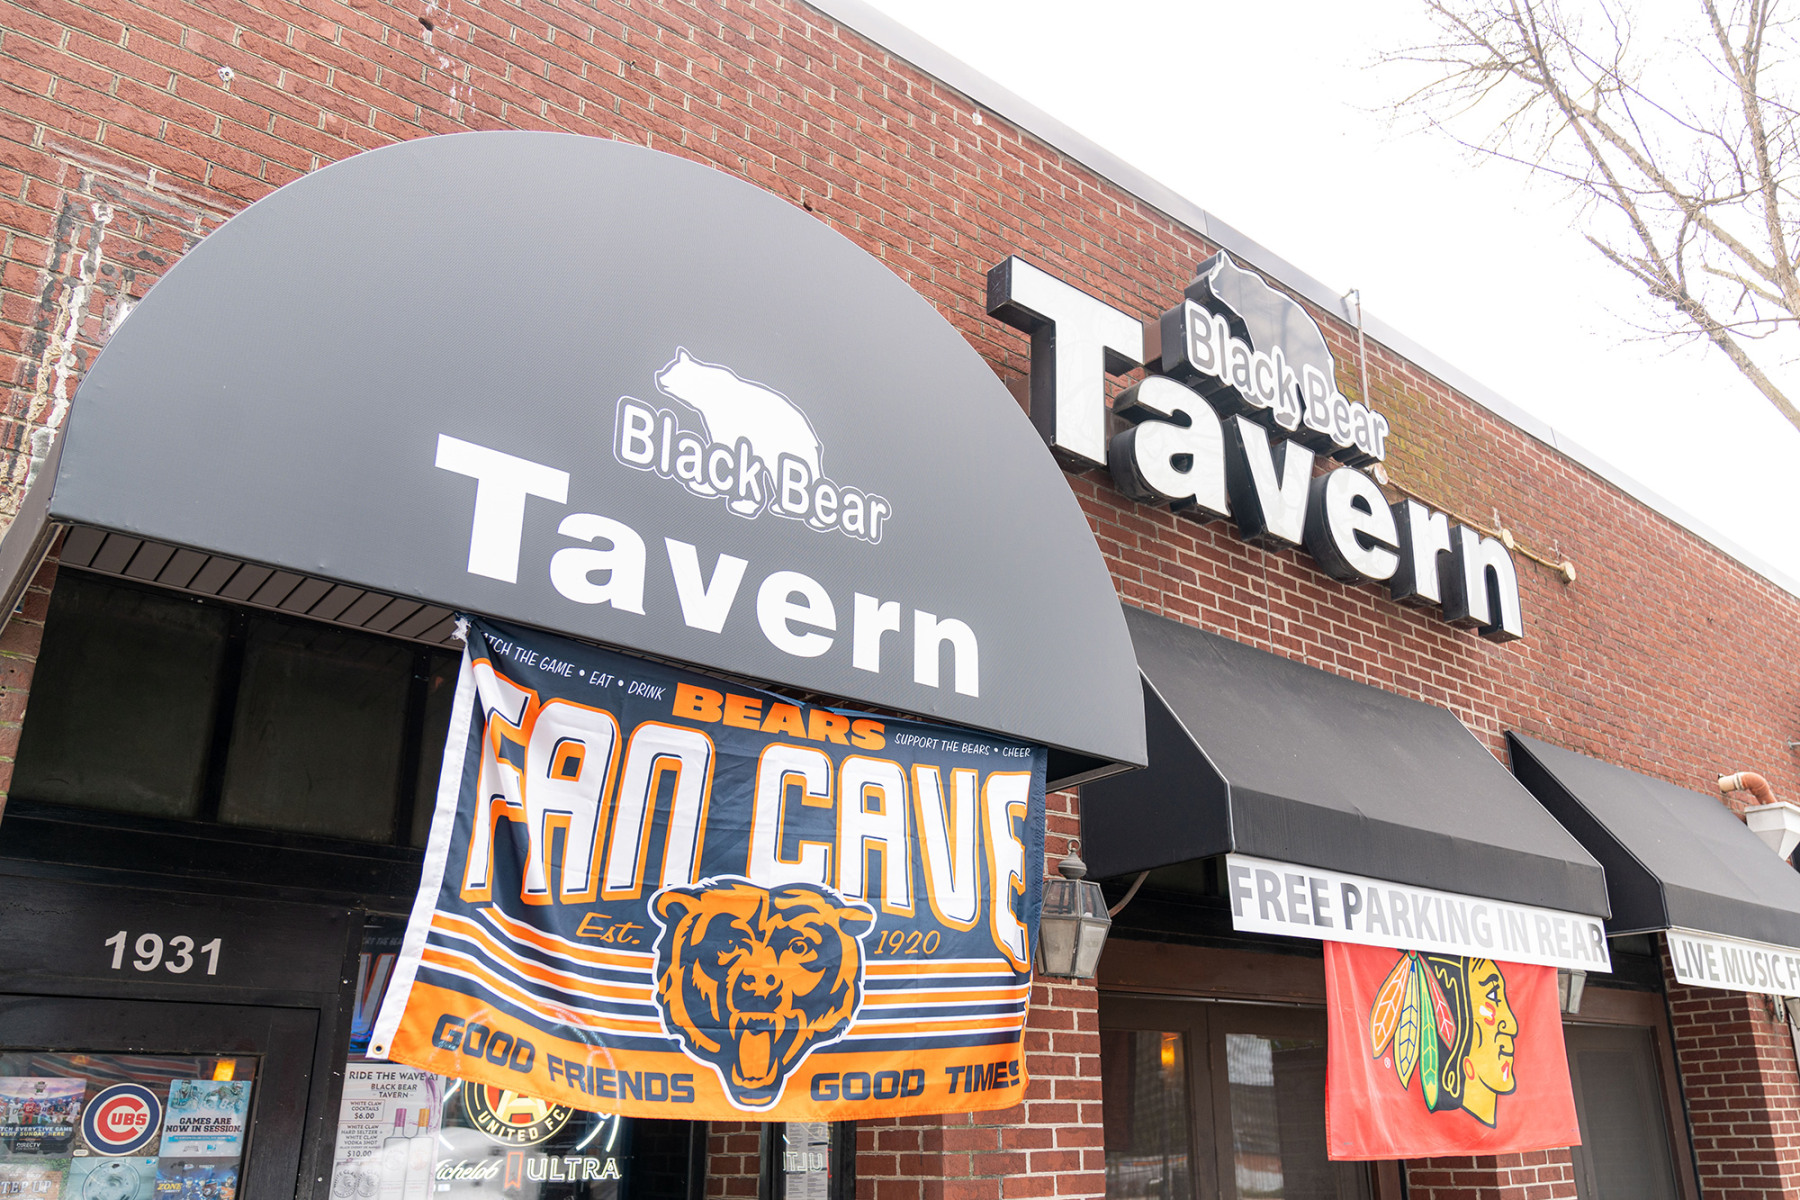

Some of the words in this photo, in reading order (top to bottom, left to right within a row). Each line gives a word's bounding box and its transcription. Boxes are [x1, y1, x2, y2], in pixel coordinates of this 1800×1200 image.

[1188, 302, 1299, 416] Black
[1304, 368, 1389, 459] Bear
[993, 254, 1523, 642] Tavern
[620, 402, 765, 503] Black
[779, 457, 889, 541] Bear
[435, 432, 980, 698] Tavern
[483, 632, 513, 656] TCH
[514, 646, 539, 666] THE
[539, 656, 575, 678] GAME
[589, 670, 615, 688] EAT
[627, 680, 667, 701] DRINK
[671, 681, 886, 751] BEARS
[894, 733, 939, 750] SUPPORT
[941, 740, 959, 752] THE
[961, 743, 991, 756] BEARS
[1002, 747, 1031, 758] CHEER
[461, 657, 715, 904] FAN
[744, 742, 1032, 974] CAVE
[574, 911, 641, 945] Est.
[874, 929, 941, 956] 1920
[1228, 864, 1334, 928] FREE
[1340, 882, 1494, 949] PARKING
[1497, 907, 1532, 956] IN
[1538, 913, 1609, 965] REAR
[105, 930, 222, 976] 1931
[1669, 937, 1721, 982] LIVE
[1720, 945, 1787, 990] MUSIC
[348, 1071, 373, 1080] RIDE
[375, 1071, 397, 1080] THE
[399, 1072, 425, 1081] WAVE
[426, 1072, 440, 1081] AT
[432, 1013, 536, 1075] GOOD
[547, 1052, 695, 1104] FRIENDS
[811, 1066, 924, 1102] GOOD
[944, 1058, 1022, 1095] TIMES
[166, 1125, 189, 1133] NOW
[191, 1125, 202, 1133] IN
[179, 1117, 212, 1125] GAMES
[213, 1117, 232, 1125] ARE
[354, 1112, 375, 1120] $6.00
[477, 1109, 539, 1142] UNITED
[544, 1108, 566, 1131] FC
[347, 1150, 372, 1158] $10.00
[526, 1157, 621, 1182] ULTRA
[0, 1180, 29, 1195] TEP
[32, 1180, 52, 1194] UP
[156, 1182, 183, 1190] ZONE
